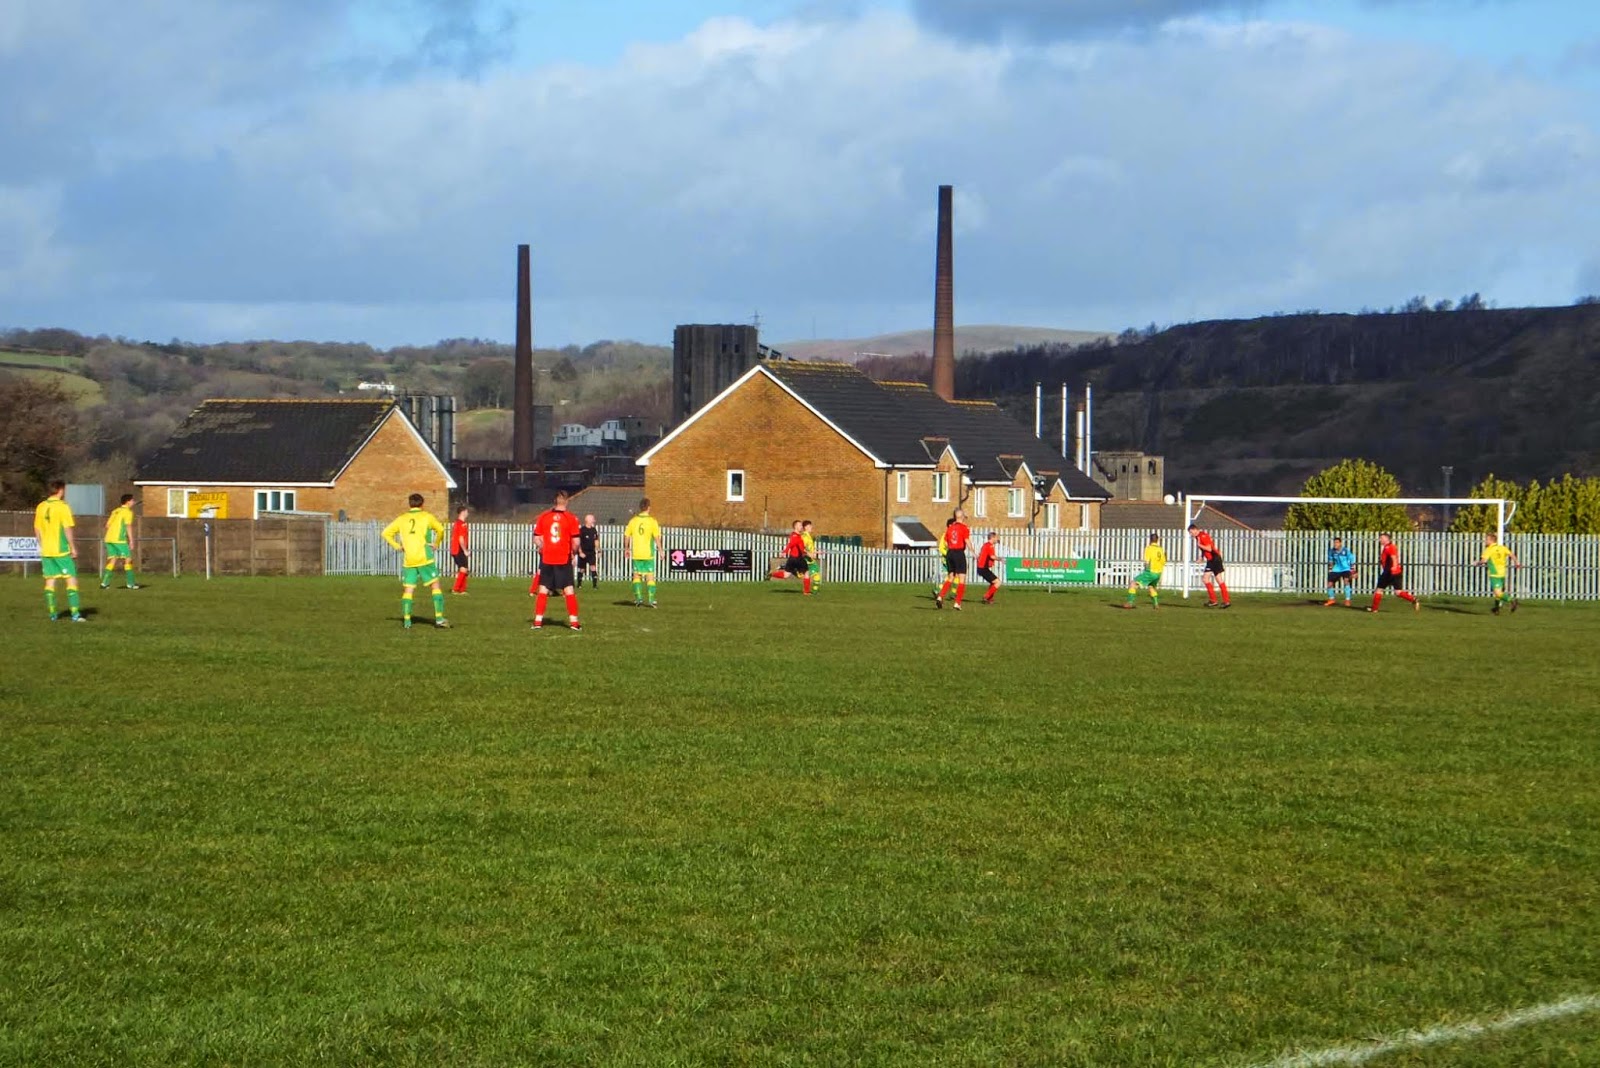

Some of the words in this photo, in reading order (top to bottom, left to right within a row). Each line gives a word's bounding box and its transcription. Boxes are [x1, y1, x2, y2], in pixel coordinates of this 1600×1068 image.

[45, 507, 50, 523] 4
[409, 518, 415, 534] 2
[638, 522, 645, 536] 6
[550, 521, 561, 544] 9
[8, 538, 38, 548] RYCON
[686, 550, 720, 558] PLASTER
[703, 556, 725, 567] Craft
[1022, 559, 1077, 568] MEDWAY
